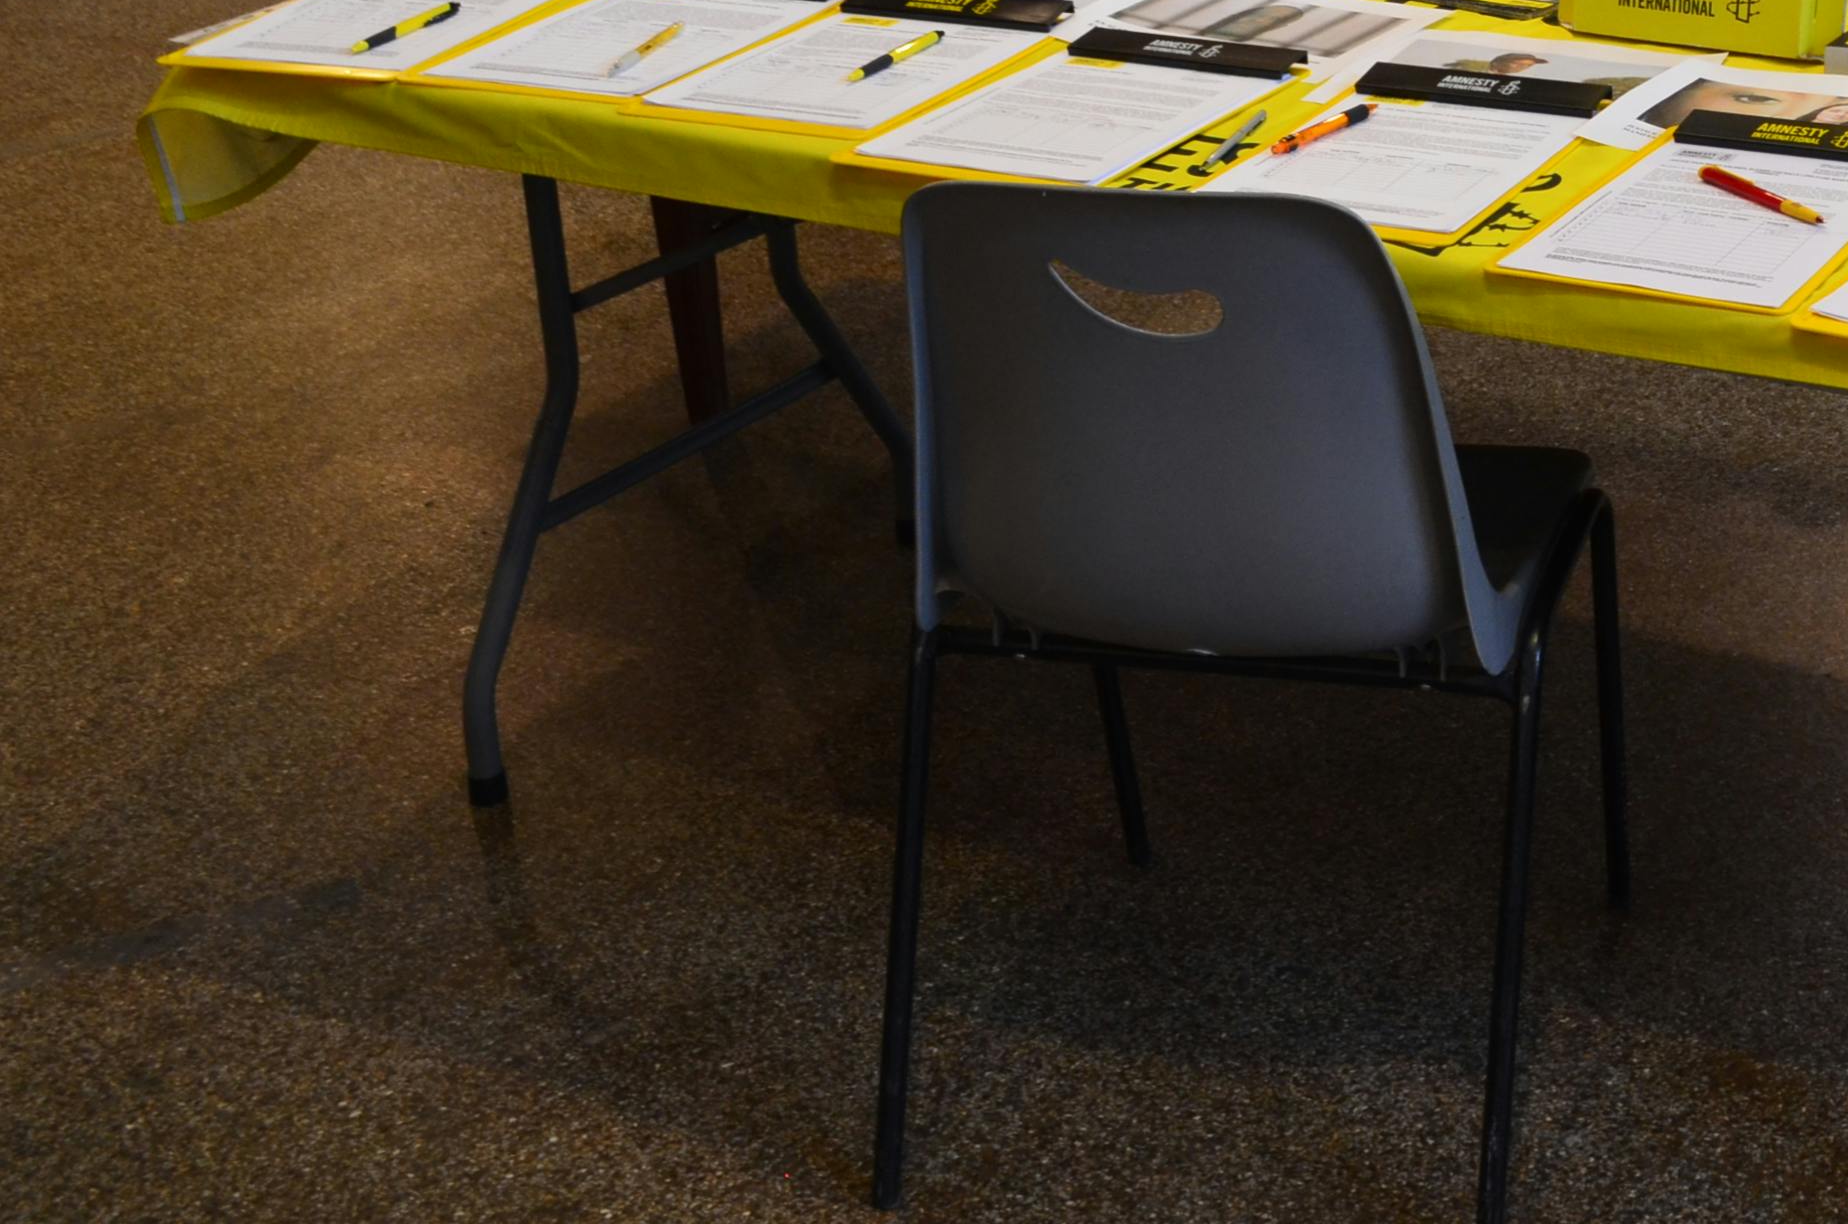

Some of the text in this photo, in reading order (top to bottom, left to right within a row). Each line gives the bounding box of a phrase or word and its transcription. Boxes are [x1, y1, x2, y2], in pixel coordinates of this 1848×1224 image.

[1149, 39, 1204, 51] AMNESTY
[1441, 75, 1500, 87] AMNESTY
[1757, 122, 1830, 138] AMNESTY
[1751, 131, 1820, 145] INTERNATIONAL
